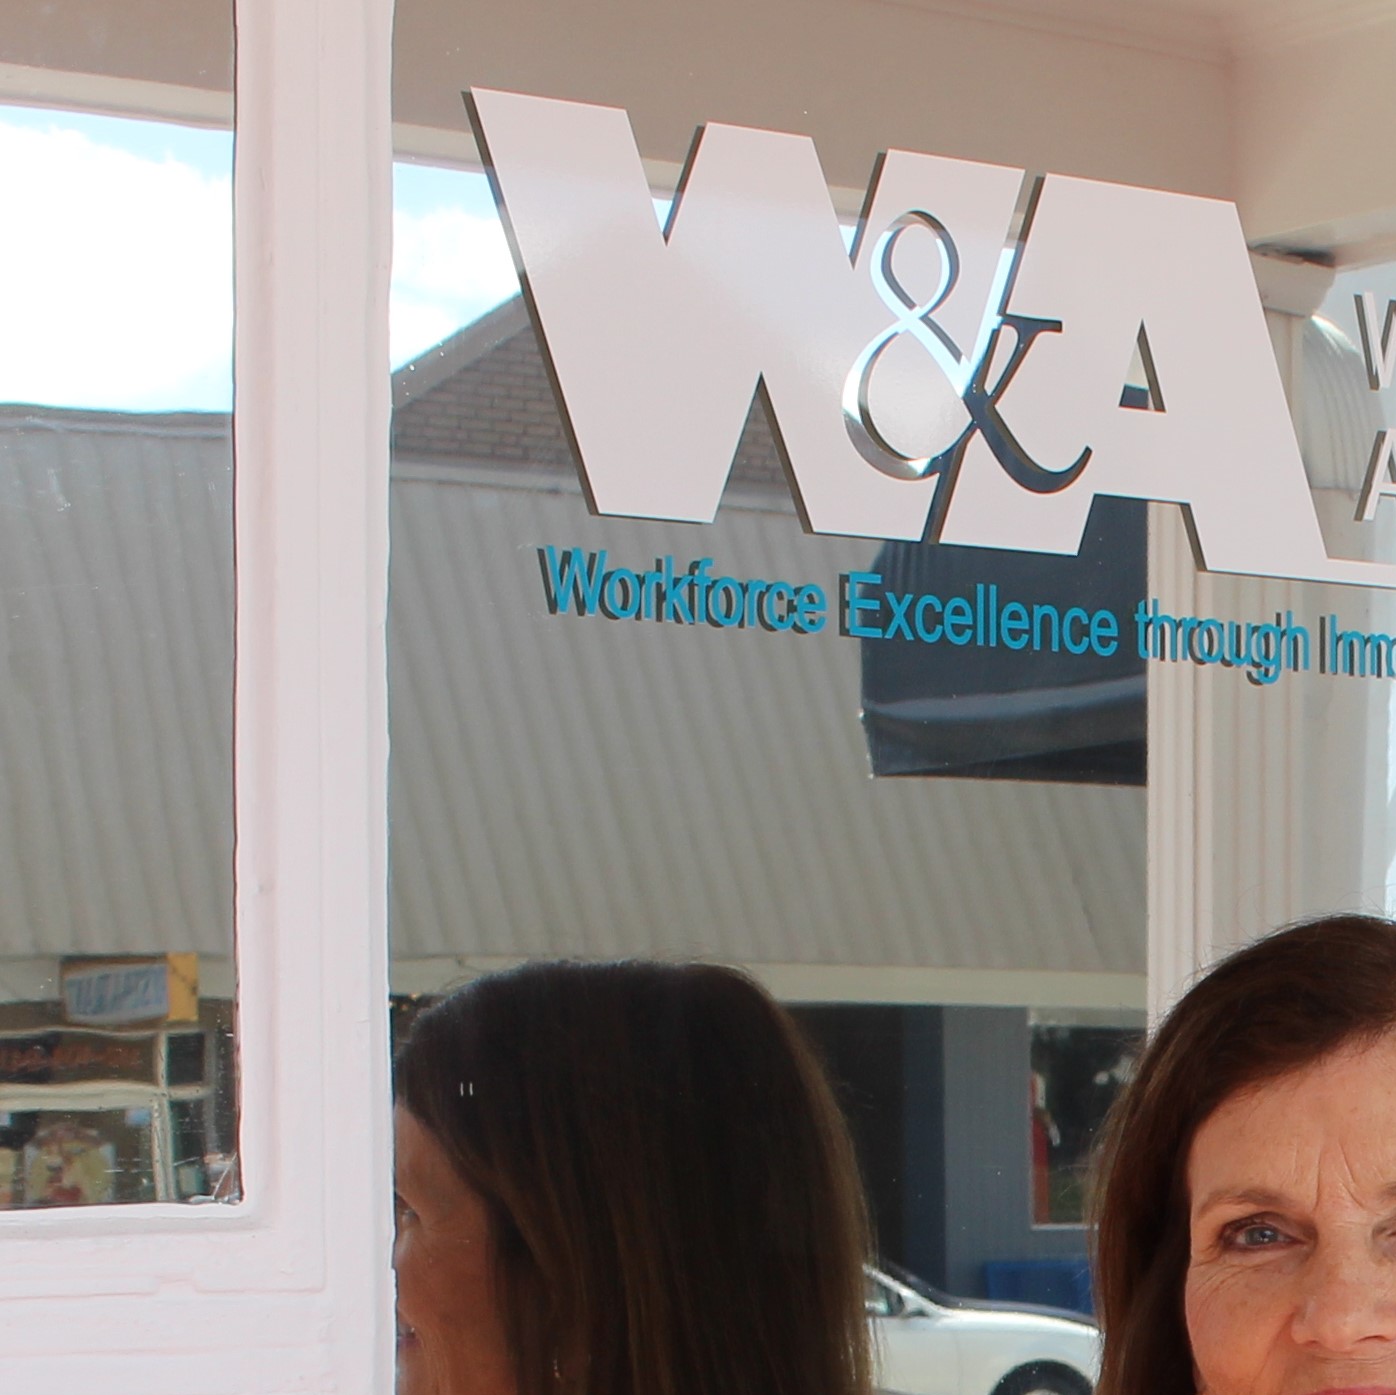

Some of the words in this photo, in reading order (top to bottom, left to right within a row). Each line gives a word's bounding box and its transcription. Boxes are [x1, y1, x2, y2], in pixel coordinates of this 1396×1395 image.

[470, 86, 1329, 572] W&A
[545, 545, 827, 633] Workforce
[848, 570, 1119, 657] Excellence
[1134, 598, 1309, 684] through
